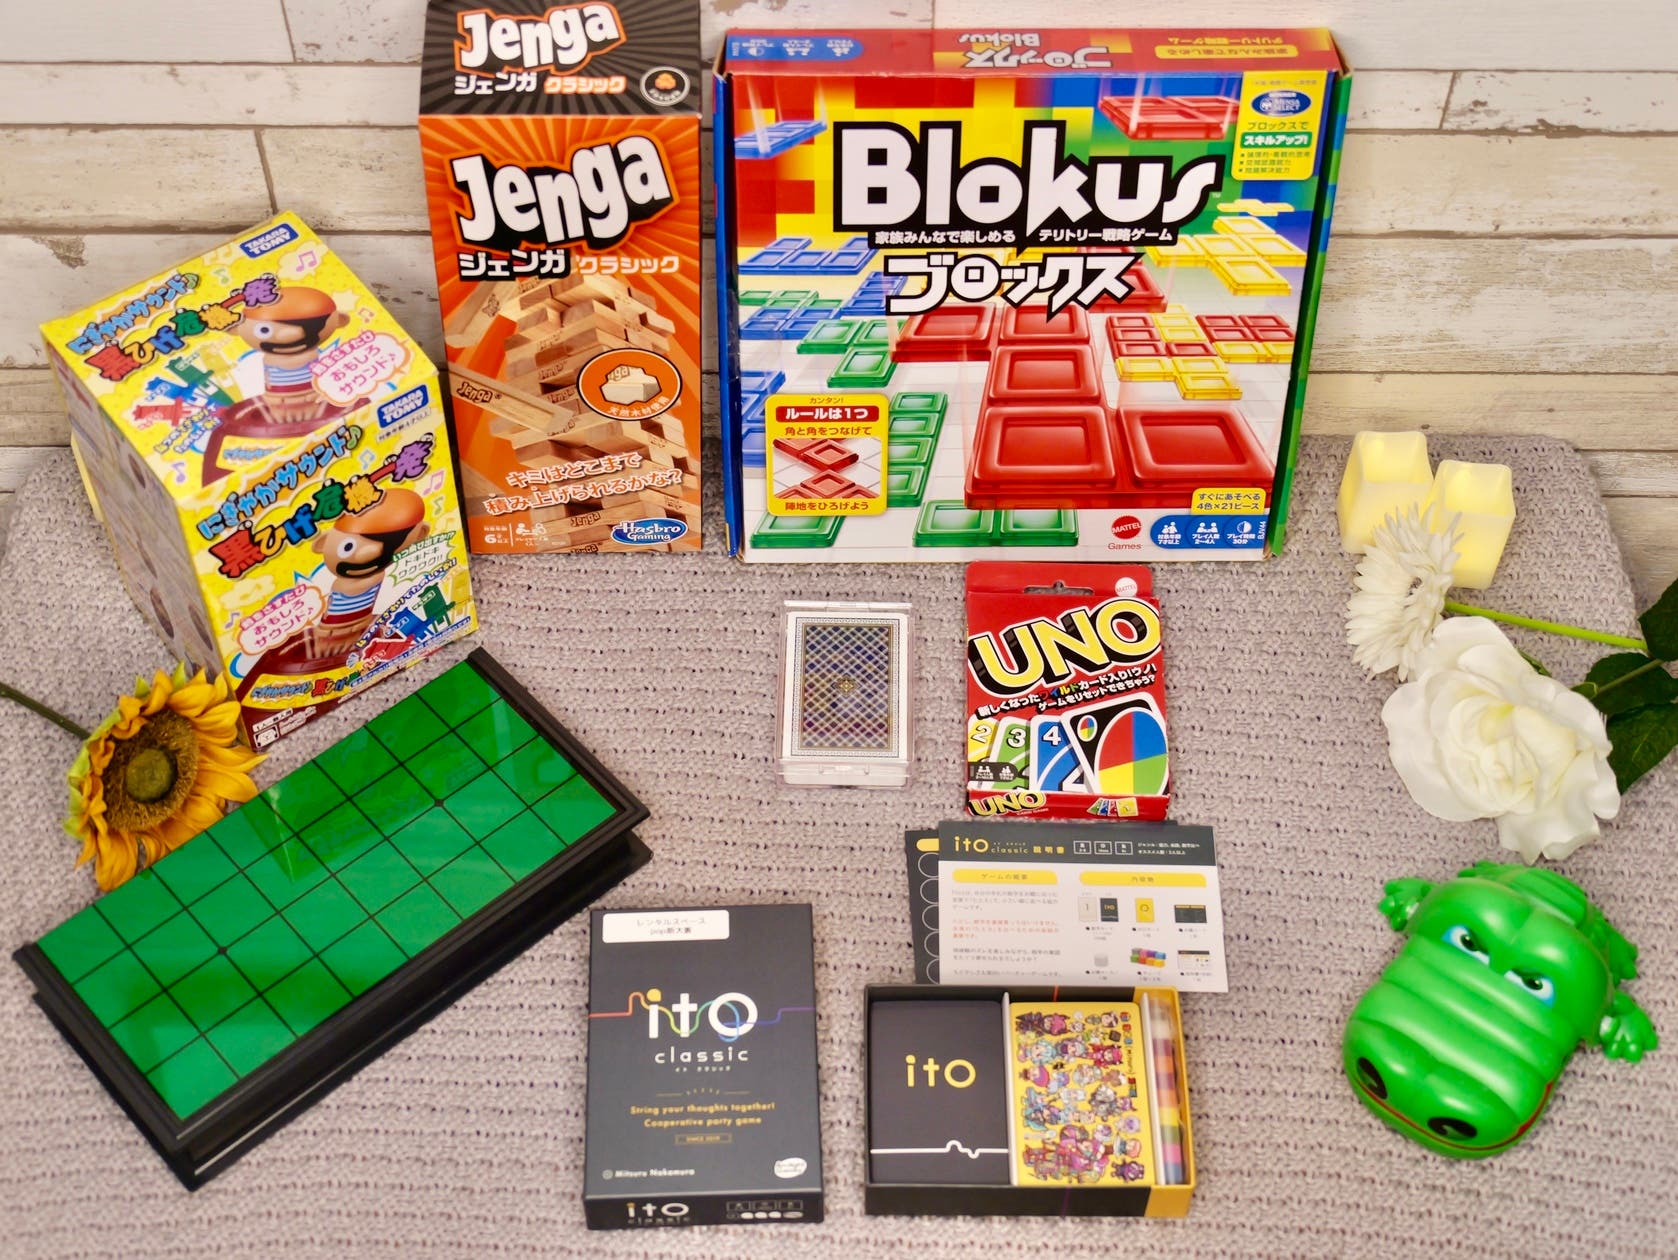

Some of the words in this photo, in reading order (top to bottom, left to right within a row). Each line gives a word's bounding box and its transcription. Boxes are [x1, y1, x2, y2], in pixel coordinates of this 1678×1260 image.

[459, 4, 621, 69] Jenga
[959, 33, 1041, 46] Blokus
[963, 46, 1113, 68] ブロックス
[454, 72, 538, 95] ジェンガ
[544, 76, 627, 94] クラシック
[1247, 121, 1309, 130] ブロックスで
[1243, 134, 1308, 146] スキルアップ!
[451, 136, 672, 244] Jenga
[841, 126, 1217, 240] Blokus
[245, 226, 288, 250] TAKARA
[249, 232, 292, 256] TOMY
[875, 230, 1016, 244] 家族みんなで楽しめる
[1038, 228, 1173, 242] テリトリー戦略ゲーム
[459, 250, 566, 278] ジェンガ
[575, 255, 680, 275] クラシック
[887, 252, 1138, 314] ブロックス
[331, 345, 381, 382] おもしろ
[382, 390, 424, 414] TAKARA
[383, 397, 425, 427] TOMY
[785, 407, 868, 420] ルールは1つ
[785, 426, 873, 436] 角と角をつなげて
[505, 451, 643, 488] キミはどこまで
[197, 427, 350, 540] にぎやかサウンド
[484, 469, 683, 515] 積み上げられるかな?
[208, 438, 434, 578] 黒ひげ危機一発
[785, 502, 869, 511] 陣地をひろげよう
[1196, 502, 1260, 510] 4色×21ピース
[614, 521, 681, 535] Hasbro
[627, 532, 671, 542] Gaming
[1112, 521, 1142, 534] MATTEL
[402, 545, 440, 567] ドキドキ
[253, 600, 306, 637] おもしろ
[970, 598, 1161, 690] UNO
[972, 724, 992, 743] 2
[1007, 728, 1027, 748] 3
[1042, 726, 1062, 746] 4
[968, 791, 1045, 817] UNO
[954, 835, 989, 853] ito
[636, 917, 706, 926] レンタルスペース
[646, 988, 759, 1039] ito
[654, 1046, 749, 1064] classic
[905, 1054, 977, 1088] ito
[630, 1106, 659, 1116] String
[662, 1106, 684, 1115] your
[687, 1104, 728, 1114] thoughts
[644, 1117, 703, 1128] Cooperative
[706, 1117, 732, 1127] party
[735, 1117, 762, 1126] game
[615, 1169, 648, 1178] Mitsuru
[650, 1168, 695, 1177] Nakamura
[626, 1202, 690, 1217] ito
